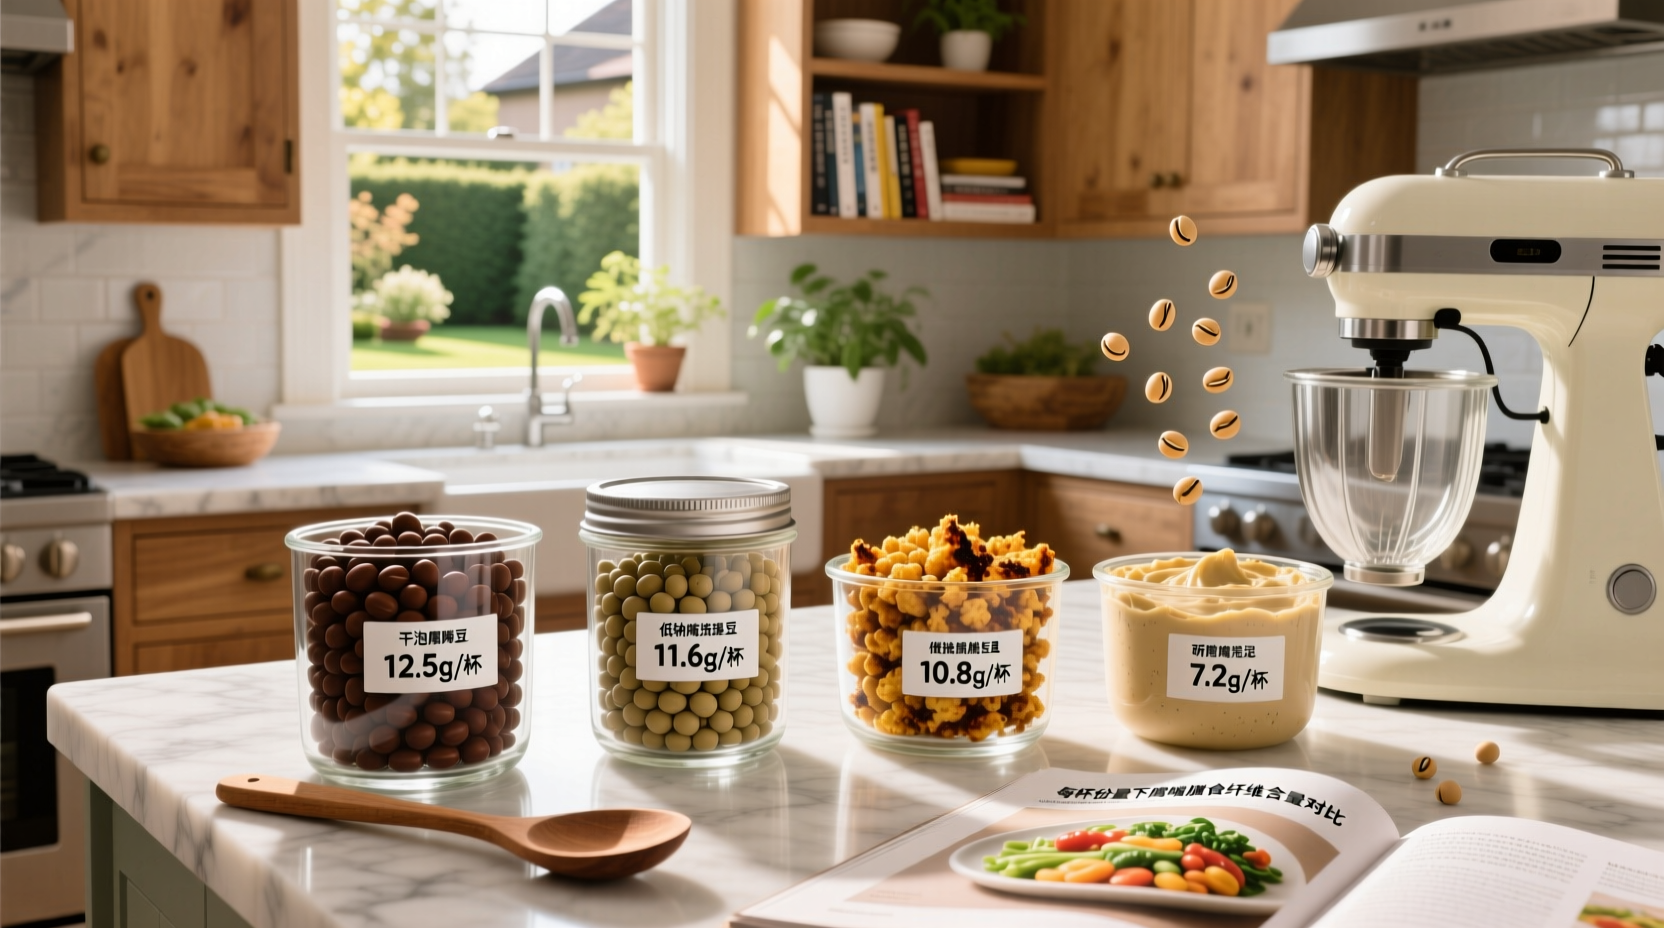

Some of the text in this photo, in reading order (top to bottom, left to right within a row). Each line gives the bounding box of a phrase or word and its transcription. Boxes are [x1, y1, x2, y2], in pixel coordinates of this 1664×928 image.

[384, 653, 482, 683] 12.5g/杯
[654, 643, 744, 673] 11.6g/杯
[920, 660, 1012, 690] 10.8g/杯
[1190, 662, 1269, 693] 7.2g/杯
